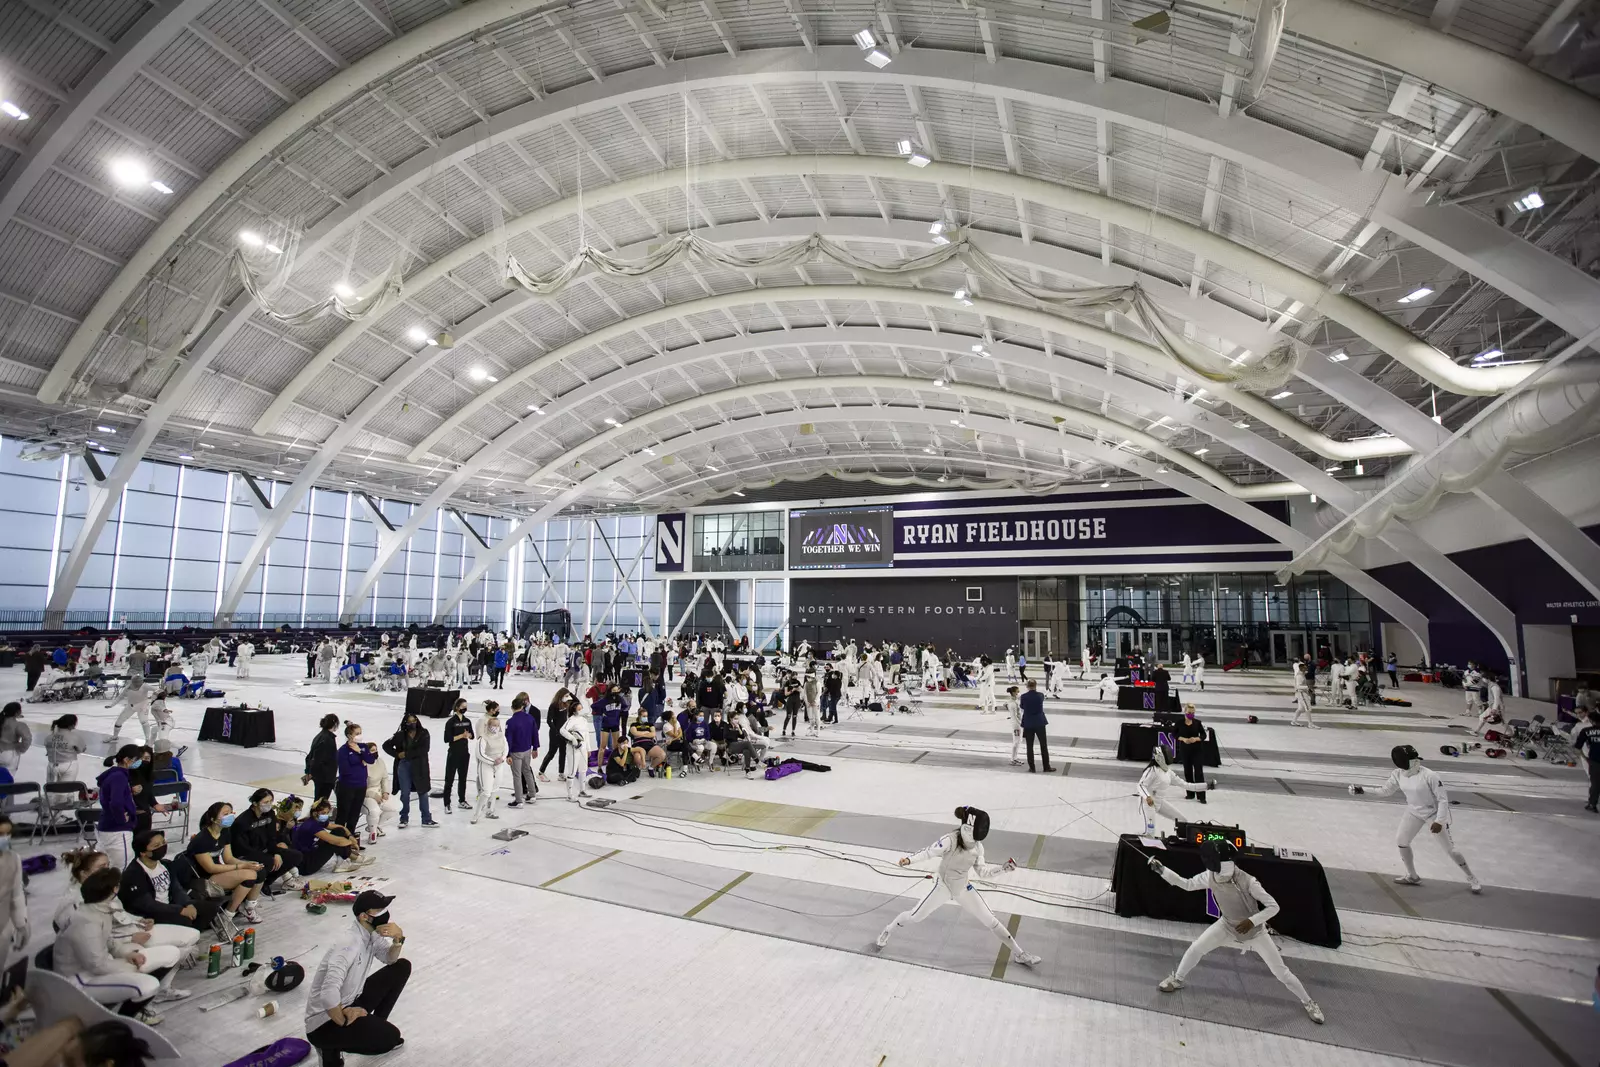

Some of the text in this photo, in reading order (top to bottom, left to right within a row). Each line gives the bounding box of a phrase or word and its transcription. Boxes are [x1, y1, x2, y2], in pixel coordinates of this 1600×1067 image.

[833, 523, 848, 545] N
[903, 517, 1107, 544] RYAN FIELDHOUSE
[657, 521, 683, 564] N
[802, 543, 880, 554] TOGETHER WE WIN
[798, 606, 1006, 615] NORTHWESTERN FOOTBALL
[1143, 692, 1155, 709] N
[222, 713, 233, 738] N
[967, 813, 977, 826] N
[1235, 837, 1242, 847] 0
